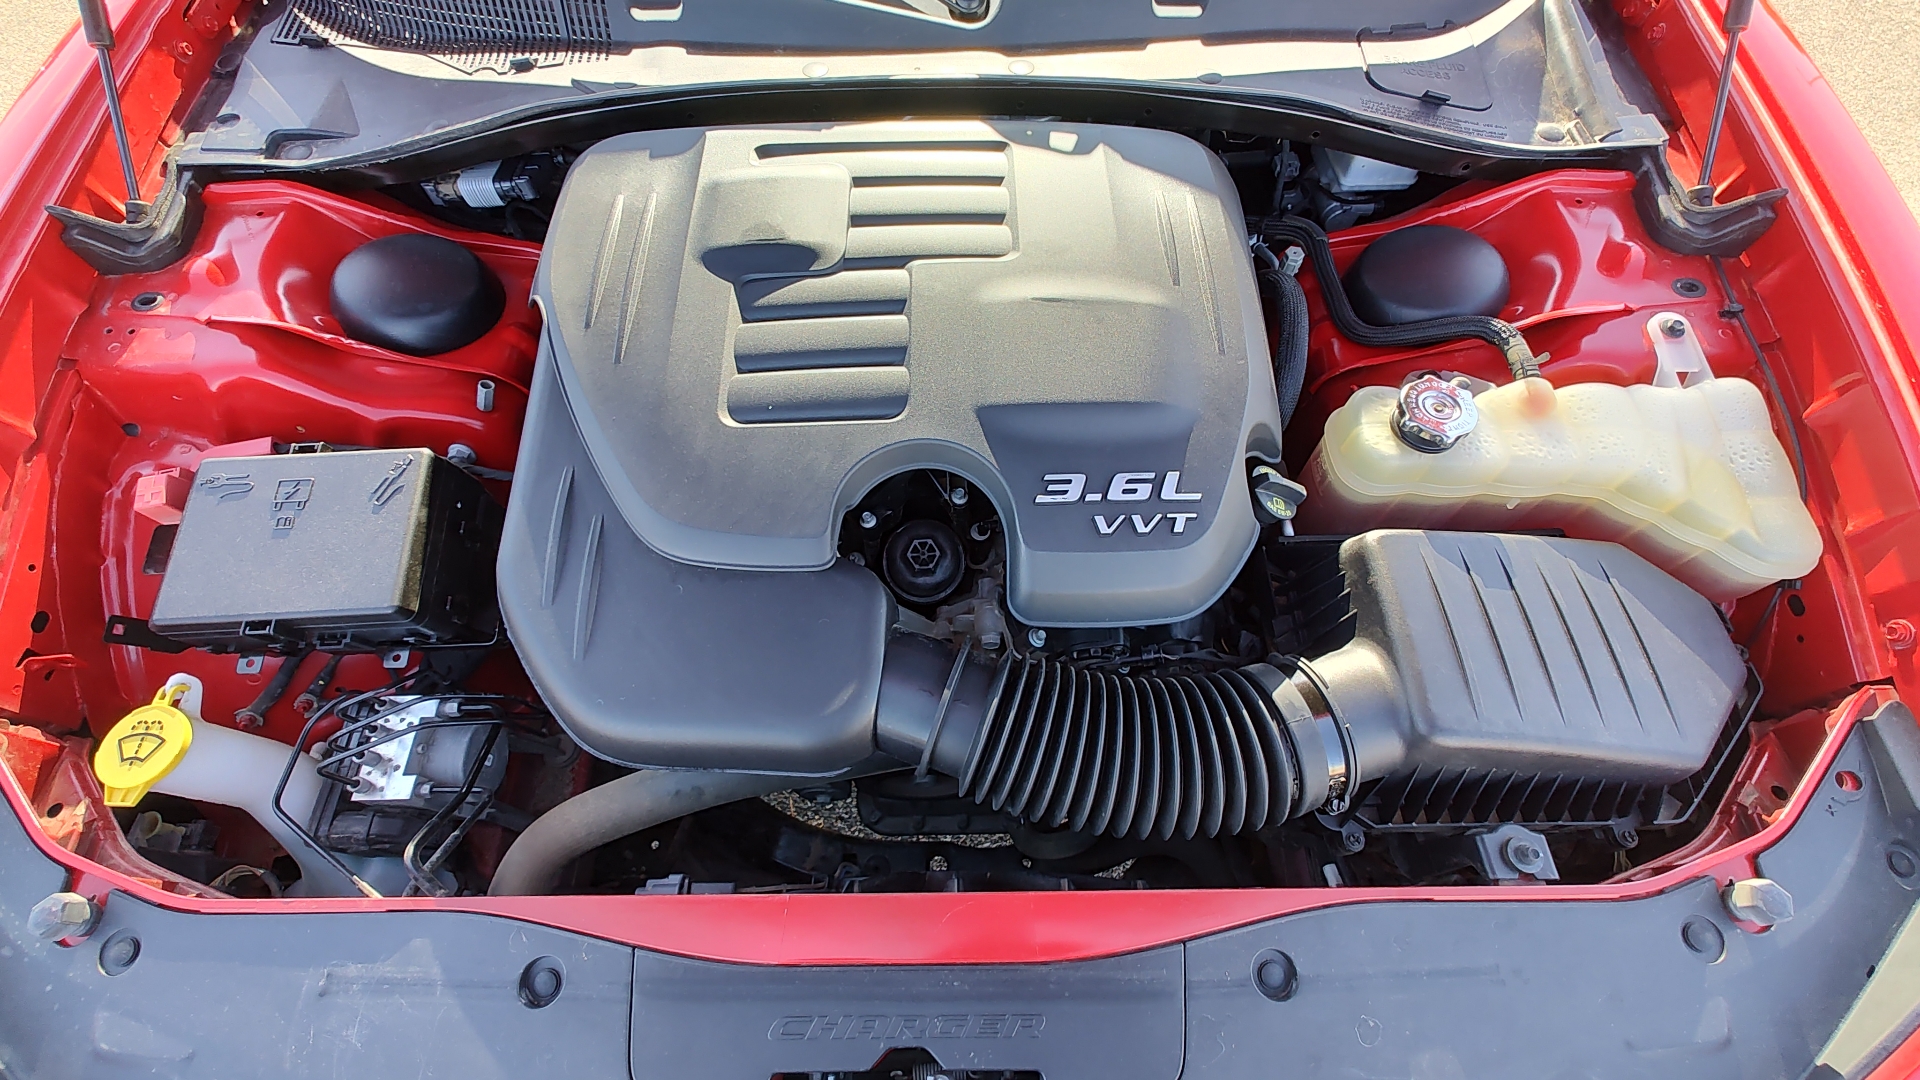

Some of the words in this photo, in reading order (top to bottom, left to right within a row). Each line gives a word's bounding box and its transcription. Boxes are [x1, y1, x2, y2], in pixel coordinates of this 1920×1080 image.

[1401, 68, 1451, 80] ACCESS
[1428, 61, 1466, 72] FLUID
[1034, 471, 1203, 506] 3.6L
[1091, 513, 1198, 536] VVT
[767, 1013, 1047, 1041] CHARGER
